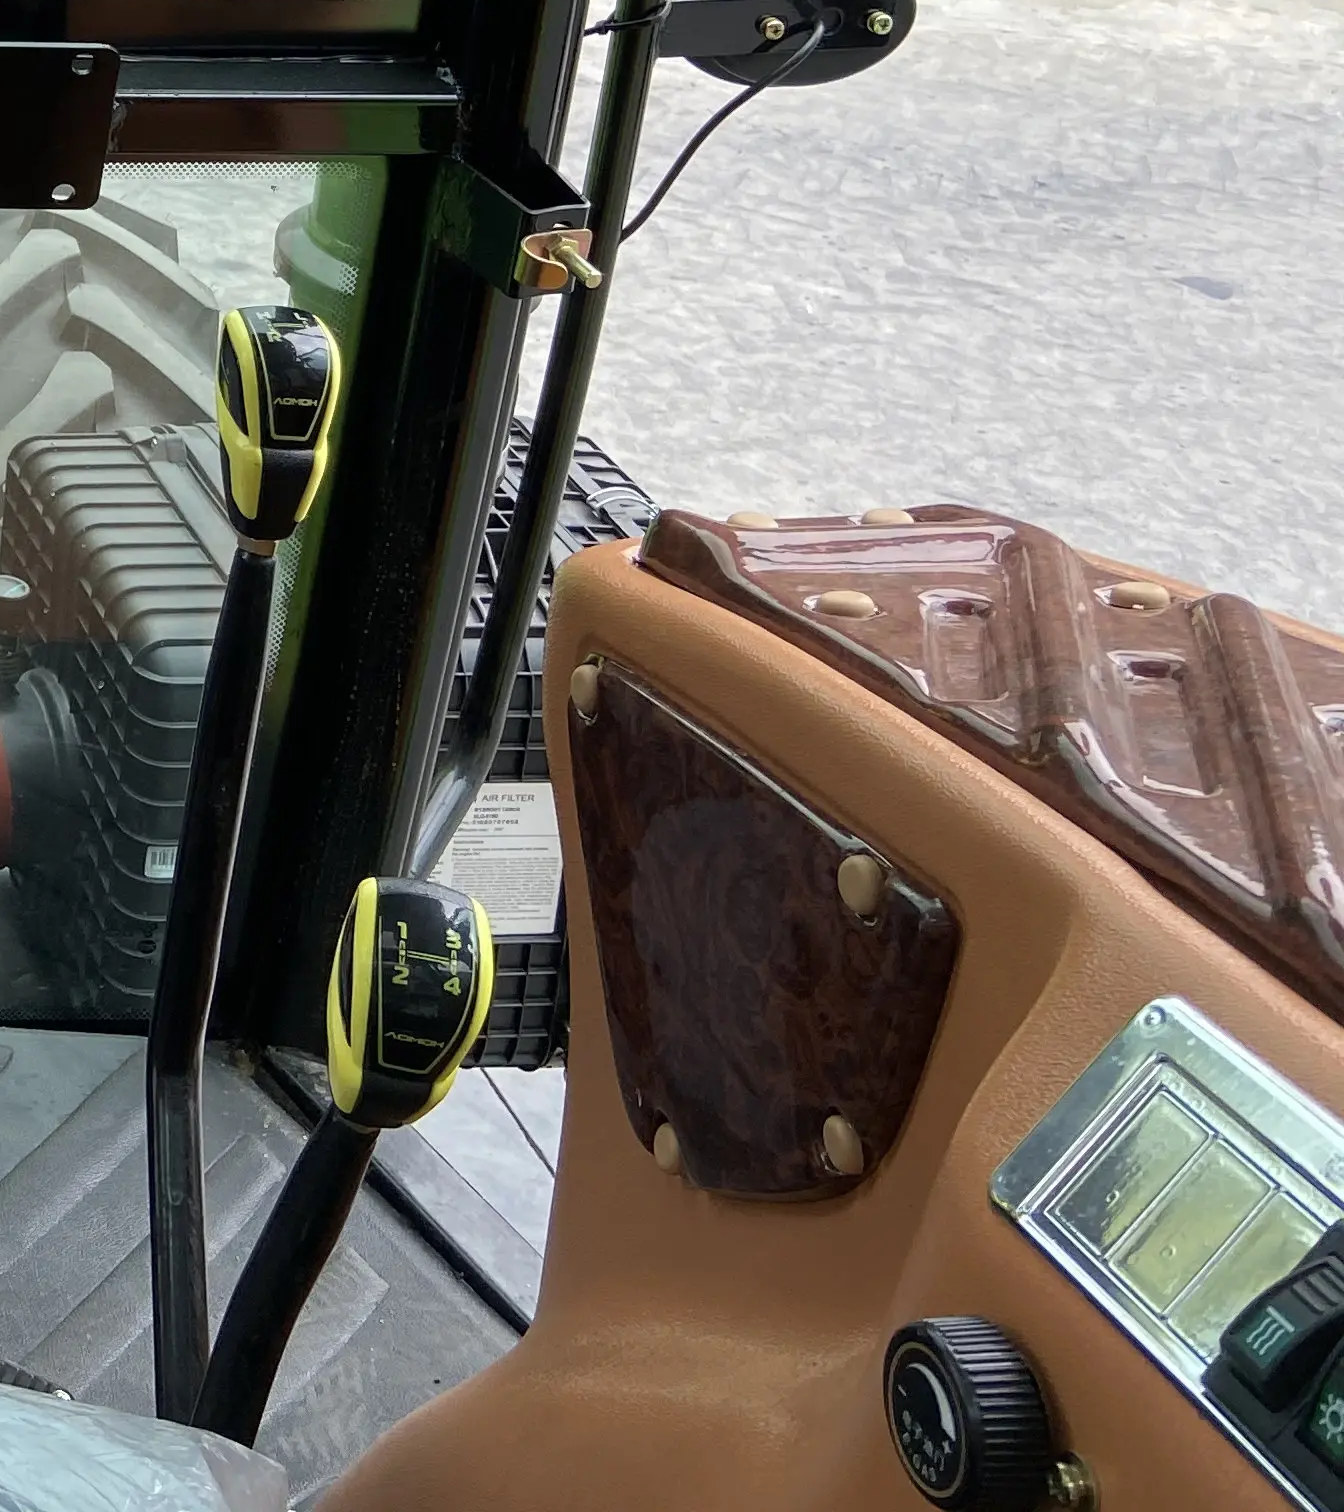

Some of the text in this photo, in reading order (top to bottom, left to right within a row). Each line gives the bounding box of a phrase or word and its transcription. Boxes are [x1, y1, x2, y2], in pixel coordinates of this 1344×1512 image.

[481, 794, 536, 803] AIR FILTER
[396, 921, 408, 940] 1
[445, 927, 462, 949] 3
[391, 965, 410, 986] 2
[442, 976, 462, 996] 4
